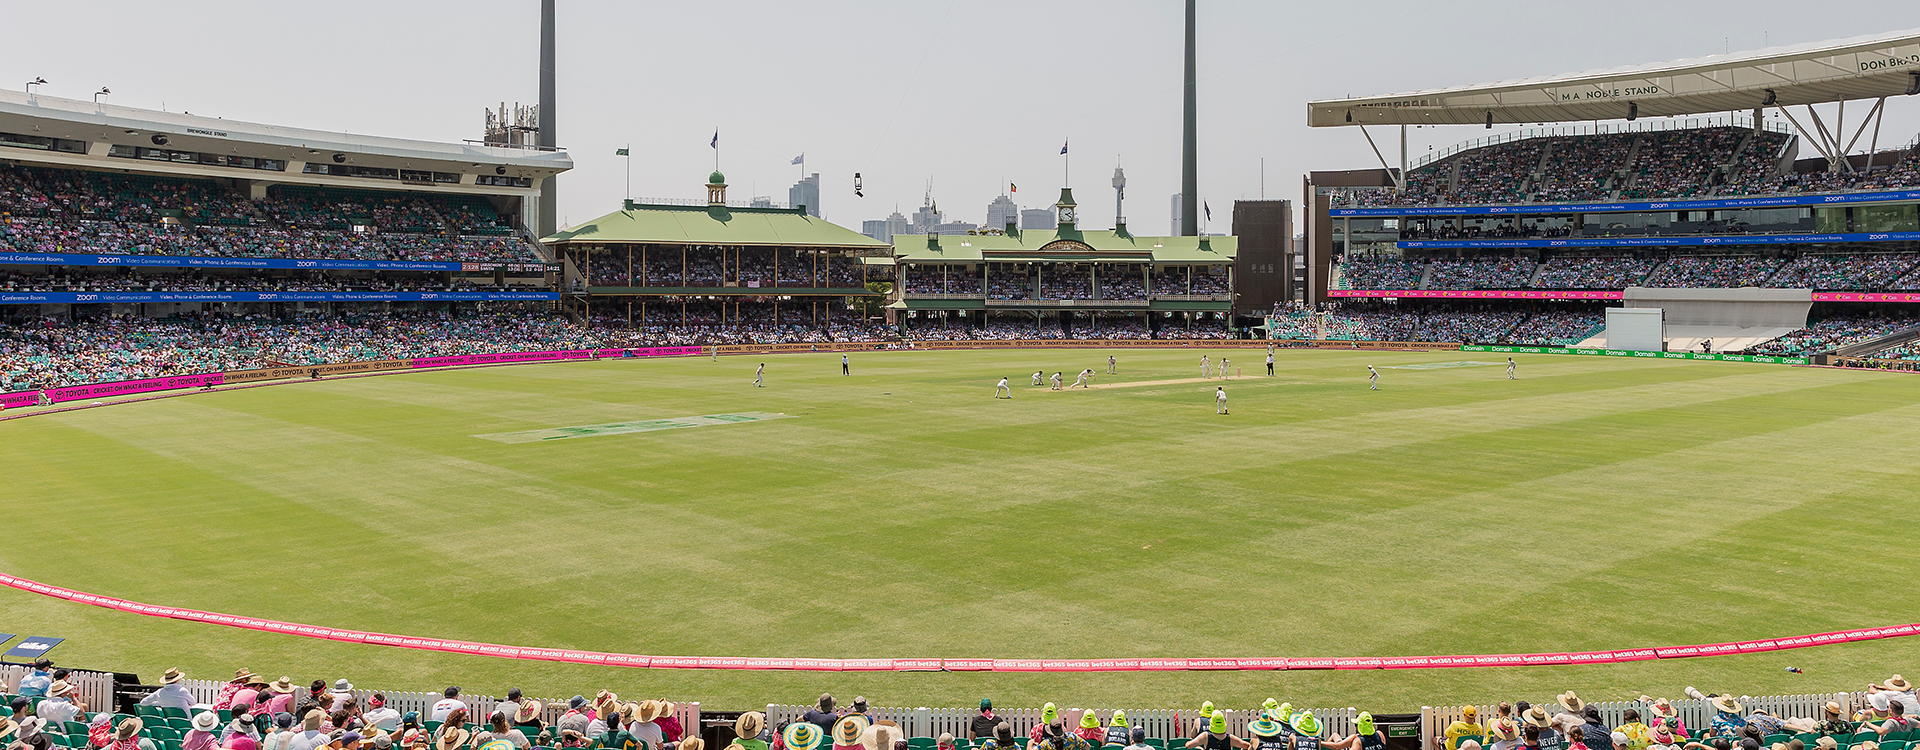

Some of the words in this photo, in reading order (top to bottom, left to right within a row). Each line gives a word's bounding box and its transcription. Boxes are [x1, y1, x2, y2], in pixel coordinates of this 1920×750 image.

[1860, 60, 1886, 70] DON
[1625, 86, 1658, 96] STAND
[187, 128, 212, 136] BREWONGLE
[66, 389, 89, 397] TOYOTA
[366, 634, 383, 642] bet365
[1811, 635, 1829, 643] bet365
[1846, 631, 1862, 639] bet365
[403, 638, 421, 646] bet365
[442, 642, 460, 650] bet365
[1777, 639, 1794, 647] bet365
[1540, 736, 1558, 746] NEVER
